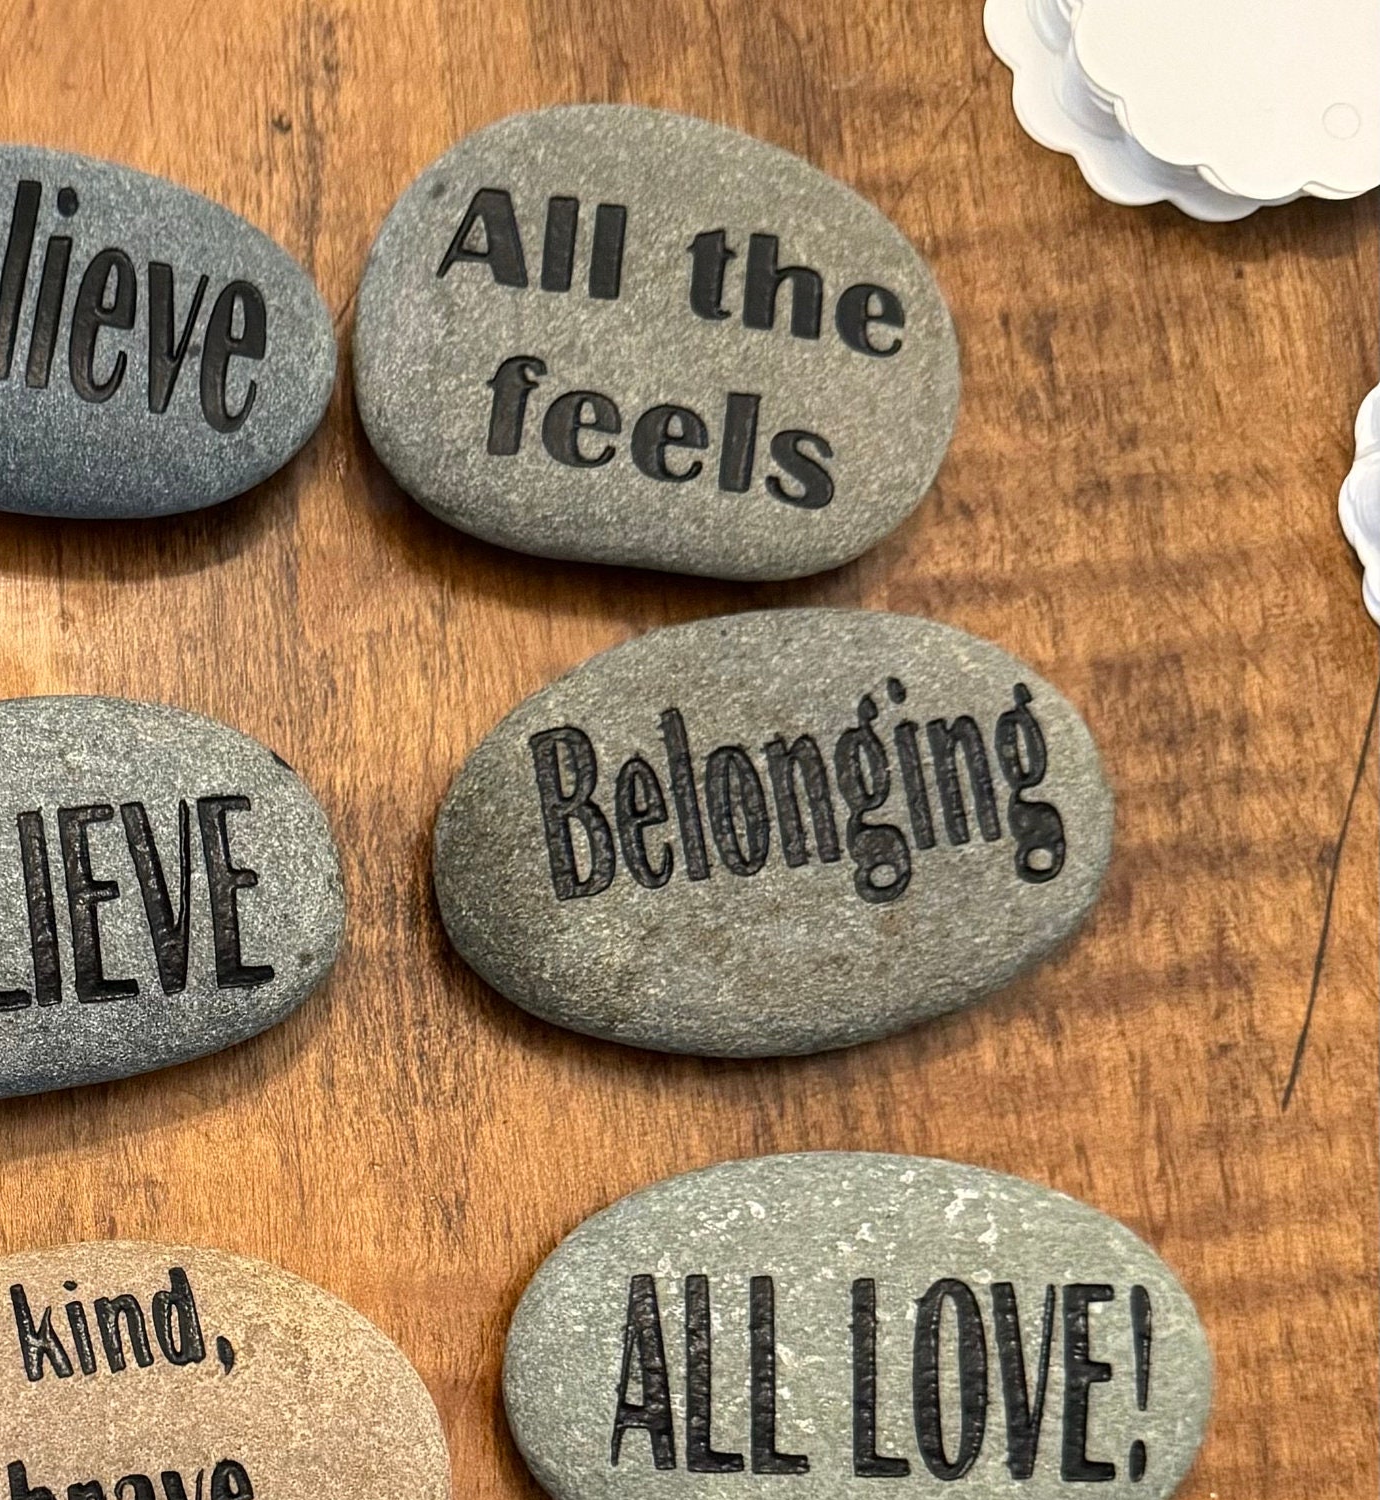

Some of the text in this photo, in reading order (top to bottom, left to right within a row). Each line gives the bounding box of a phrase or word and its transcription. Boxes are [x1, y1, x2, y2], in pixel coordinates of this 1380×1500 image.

[436, 187, 905, 357] All the
[486, 353, 835, 509] feels
[528, 677, 1067, 906] Belonging
[10, 1267, 236, 1382] kind,
[611, 1274, 1153, 1483] ALL LOVE!
